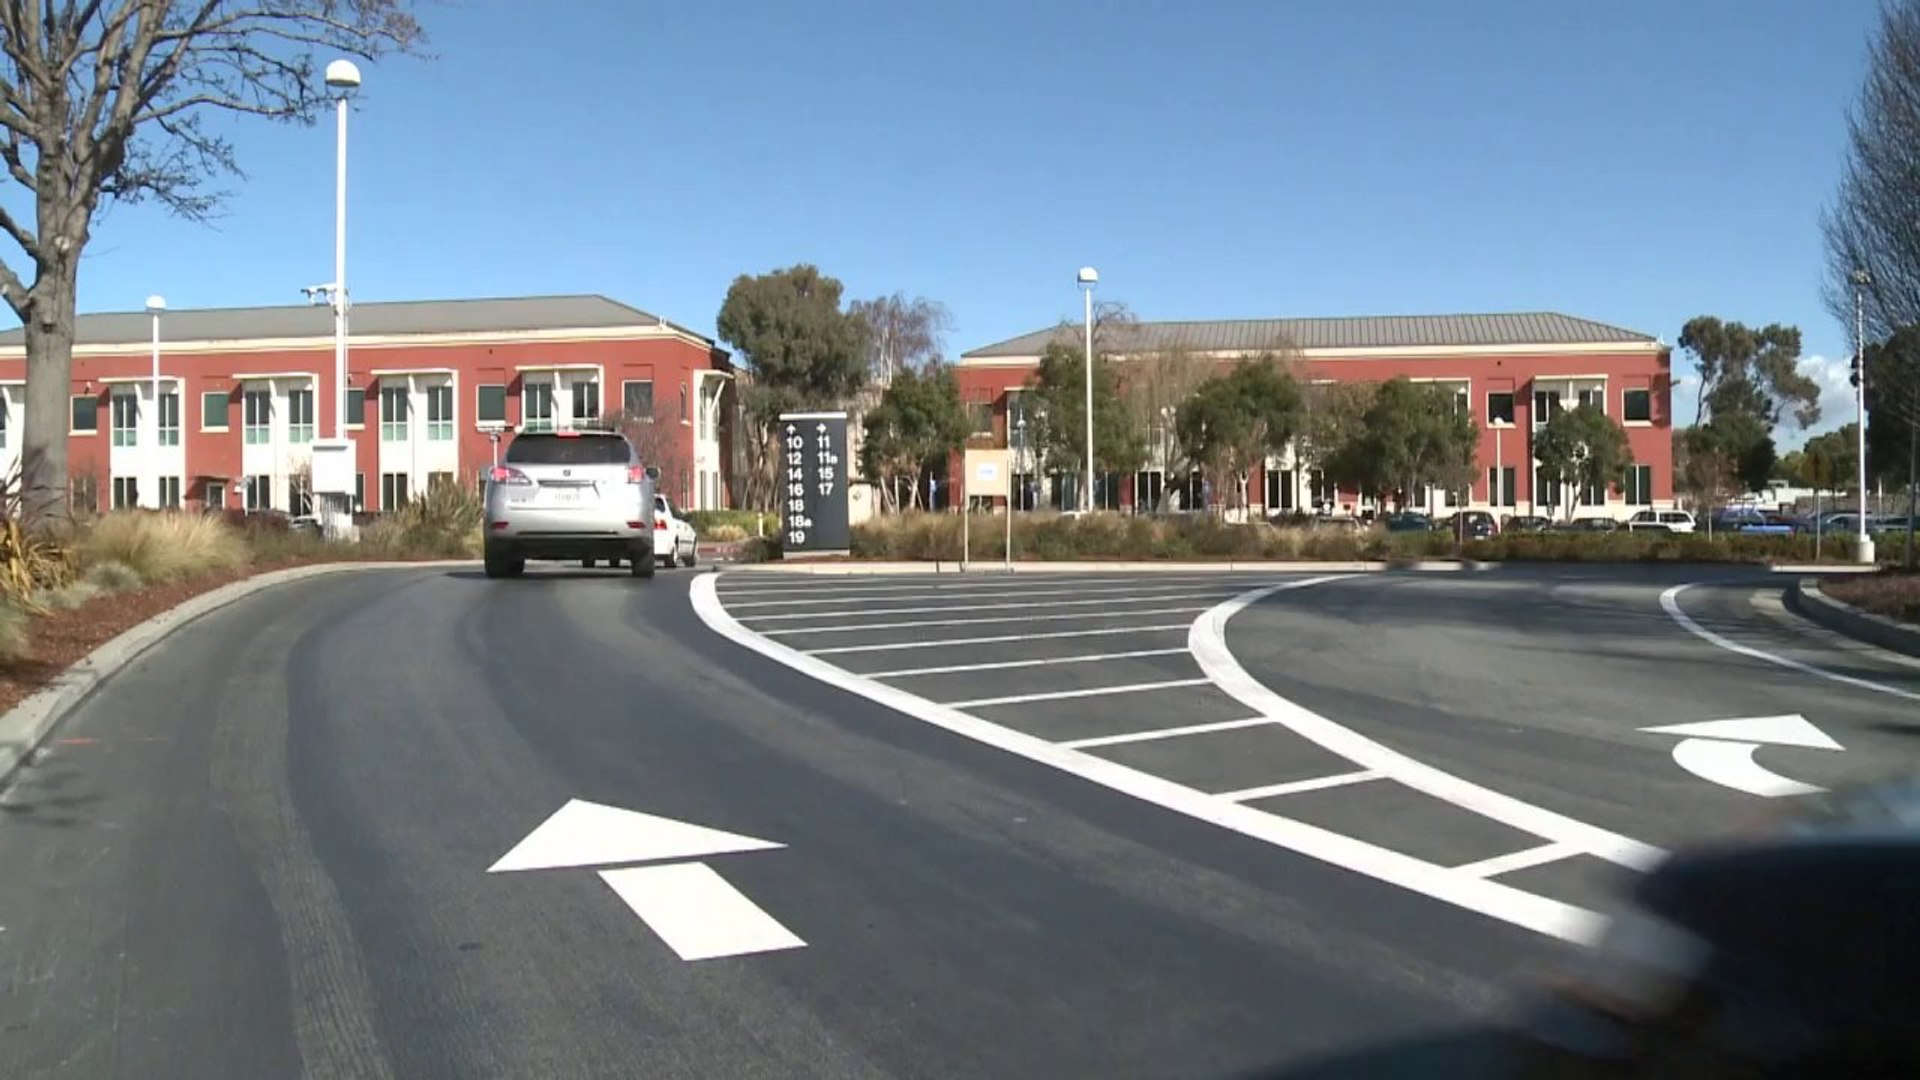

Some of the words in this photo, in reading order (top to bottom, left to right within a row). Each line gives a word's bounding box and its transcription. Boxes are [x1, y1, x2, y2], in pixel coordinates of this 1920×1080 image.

[786, 435, 804, 450] 10
[817, 435, 831, 450] 11
[786, 451, 803, 465] 12
[787, 467, 804, 481] 14
[818, 466, 834, 481] 15
[787, 483, 804, 497] 16
[818, 482, 834, 496] 17
[788, 499, 805, 513] 18
[788, 530, 805, 544] 19
